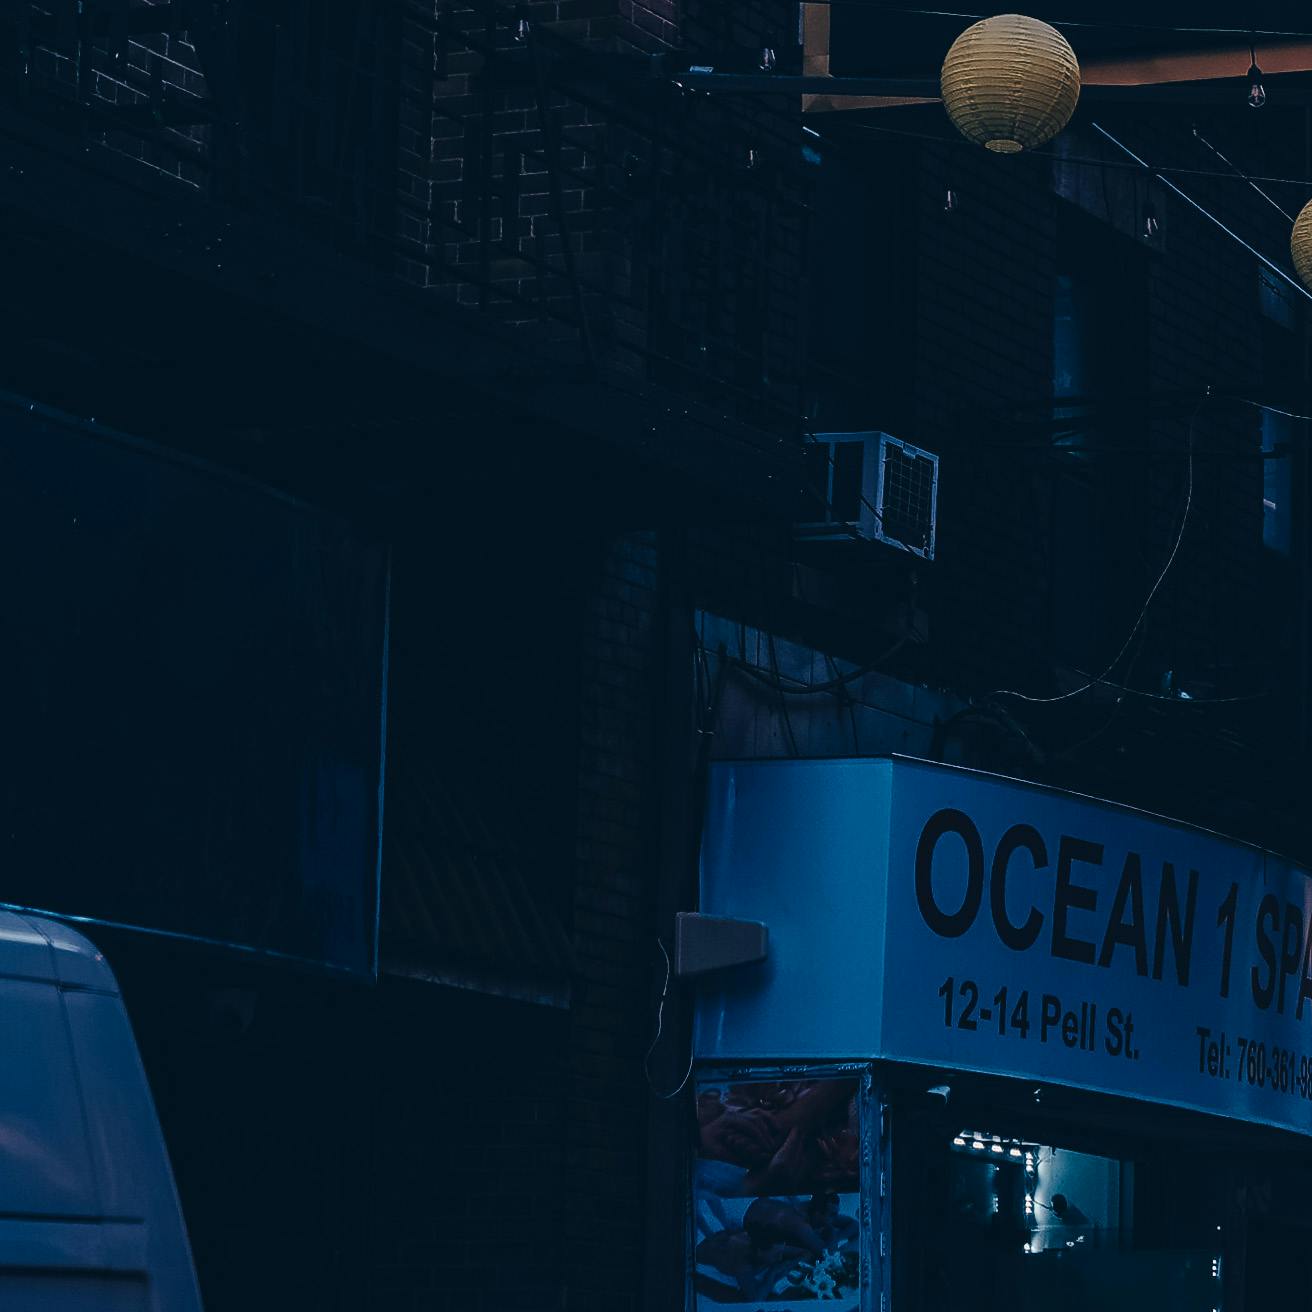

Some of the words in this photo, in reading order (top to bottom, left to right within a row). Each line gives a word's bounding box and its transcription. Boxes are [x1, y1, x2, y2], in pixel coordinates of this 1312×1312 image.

[914, 806, 1199, 988] OCEAN
[1216, 882, 1239, 999] 1
[937, 976, 1029, 1038] 12-14
[1040, 993, 1097, 1052] Pell
[1105, 1007, 1141, 1060] St.
[1195, 1027, 1231, 1081] Tel:
